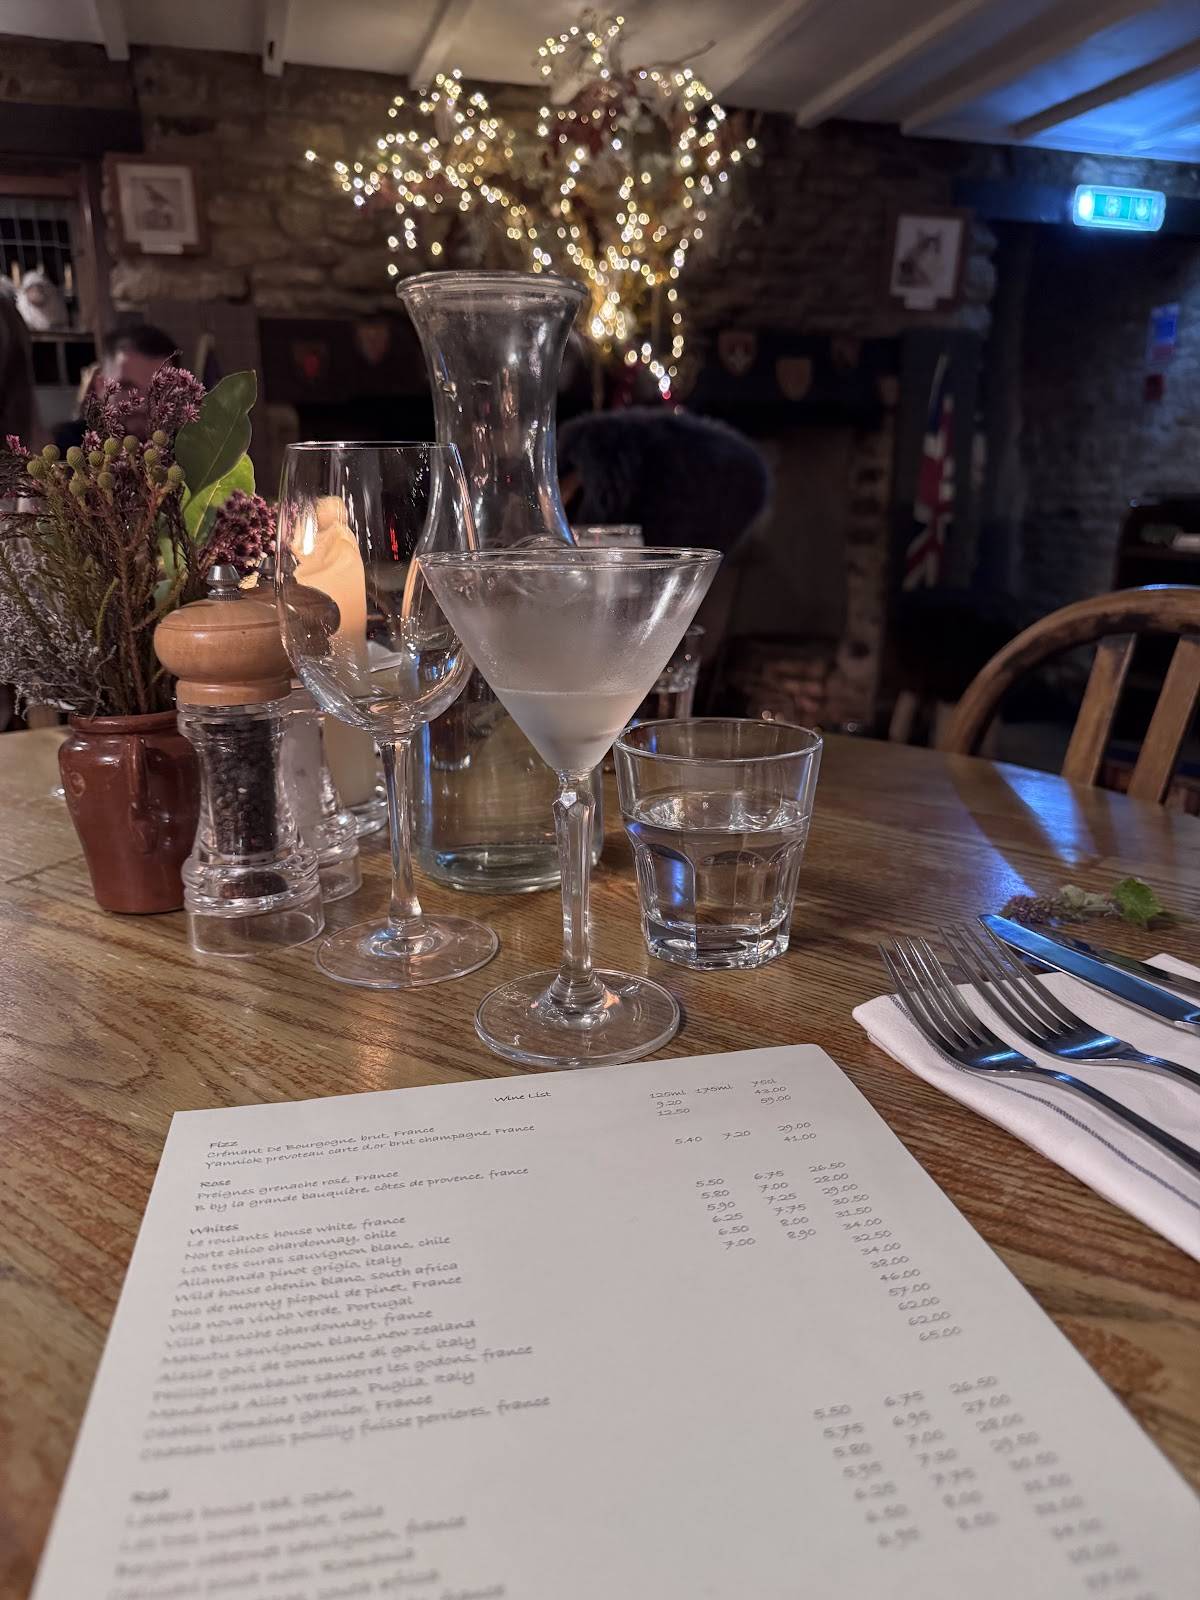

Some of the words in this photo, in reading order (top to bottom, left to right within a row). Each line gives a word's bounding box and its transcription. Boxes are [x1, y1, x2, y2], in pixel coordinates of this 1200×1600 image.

[649, 1090, 686, 1099] 125ml
[696, 1084, 733, 1094] 175ml
[656, 1100, 682, 1109] 9.20
[657, 1108, 690, 1116] 12.50
[760, 1094, 791, 1105] 59.00
[328, 1146, 358, 1155] carte
[389, 1138, 415, 1147] brut
[495, 1125, 535, 1134] France
[394, 1127, 434, 1137] France
[675, 1136, 703, 1144] 5.40
[722, 1130, 751, 1140] 7.20
[777, 1122, 811, 1133] 29.00
[209, 1141, 238, 1149] Fizz
[259, 1181, 318, 1195] grenache
[355, 1171, 398, 1182] France
[696, 1178, 724, 1188] 5.50
[754, 1170, 784, 1180] 6.75
[808, 1162, 846, 1173] 26.50
[210, 1203, 227, 1213] by
[249, 1194, 297, 1208] grande
[409, 1179, 423, 1187] de
[489, 1168, 529, 1179] france
[759, 1182, 789, 1193] 7.00
[707, 1201, 736, 1212] 5.90
[766, 1193, 797, 1205] 7.25
[821, 1183, 858, 1197] 29.00
[712, 1212, 743, 1223] 6.25
[773, 1203, 807, 1216] 7.75
[832, 1194, 870, 1205] 30.50
[190, 1224, 239, 1235] Whites
[274, 1228, 312, 1238] house
[361, 1217, 405, 1230] france
[718, 1225, 749, 1236] 6.50
[835, 1206, 872, 1218] 31.50
[364, 1230, 397, 1240] chile
[722, 1237, 756, 1250] 7.00
[842, 1218, 882, 1230] 34.00
[852, 1230, 892, 1243] 32.50
[288, 1248, 367, 1262] sauvignon
[418, 1237, 451, 1247] chile
[860, 1242, 901, 1256] 34.00
[269, 1267, 307, 1281] pinot
[366, 1256, 402, 1267] italy
[880, 1268, 921, 1281] 46.00
[218, 1286, 261, 1298] house
[265, 1279, 317, 1292] chenin
[370, 1268, 411, 1280] south
[415, 1263, 458, 1275] africa
[206, 1304, 224, 1314] de
[345, 1288, 361, 1298] de
[412, 1276, 462, 1289] France
[888, 1282, 931, 1297] 57.00
[346, 1296, 413, 1312] Portugal
[898, 1296, 940, 1311] 62.00
[384, 1310, 433, 1326] france
[908, 1311, 952, 1326] 62.00
[919, 1326, 962, 1342] 65.00
[235, 1341, 324, 1358] sauvignon
[261, 1362, 280, 1372] de
[436, 1336, 476, 1350] italy
[387, 1363, 409, 1373] les
[481, 1346, 533, 1362] france
[375, 1395, 433, 1411] France
[496, 1397, 550, 1415] france
